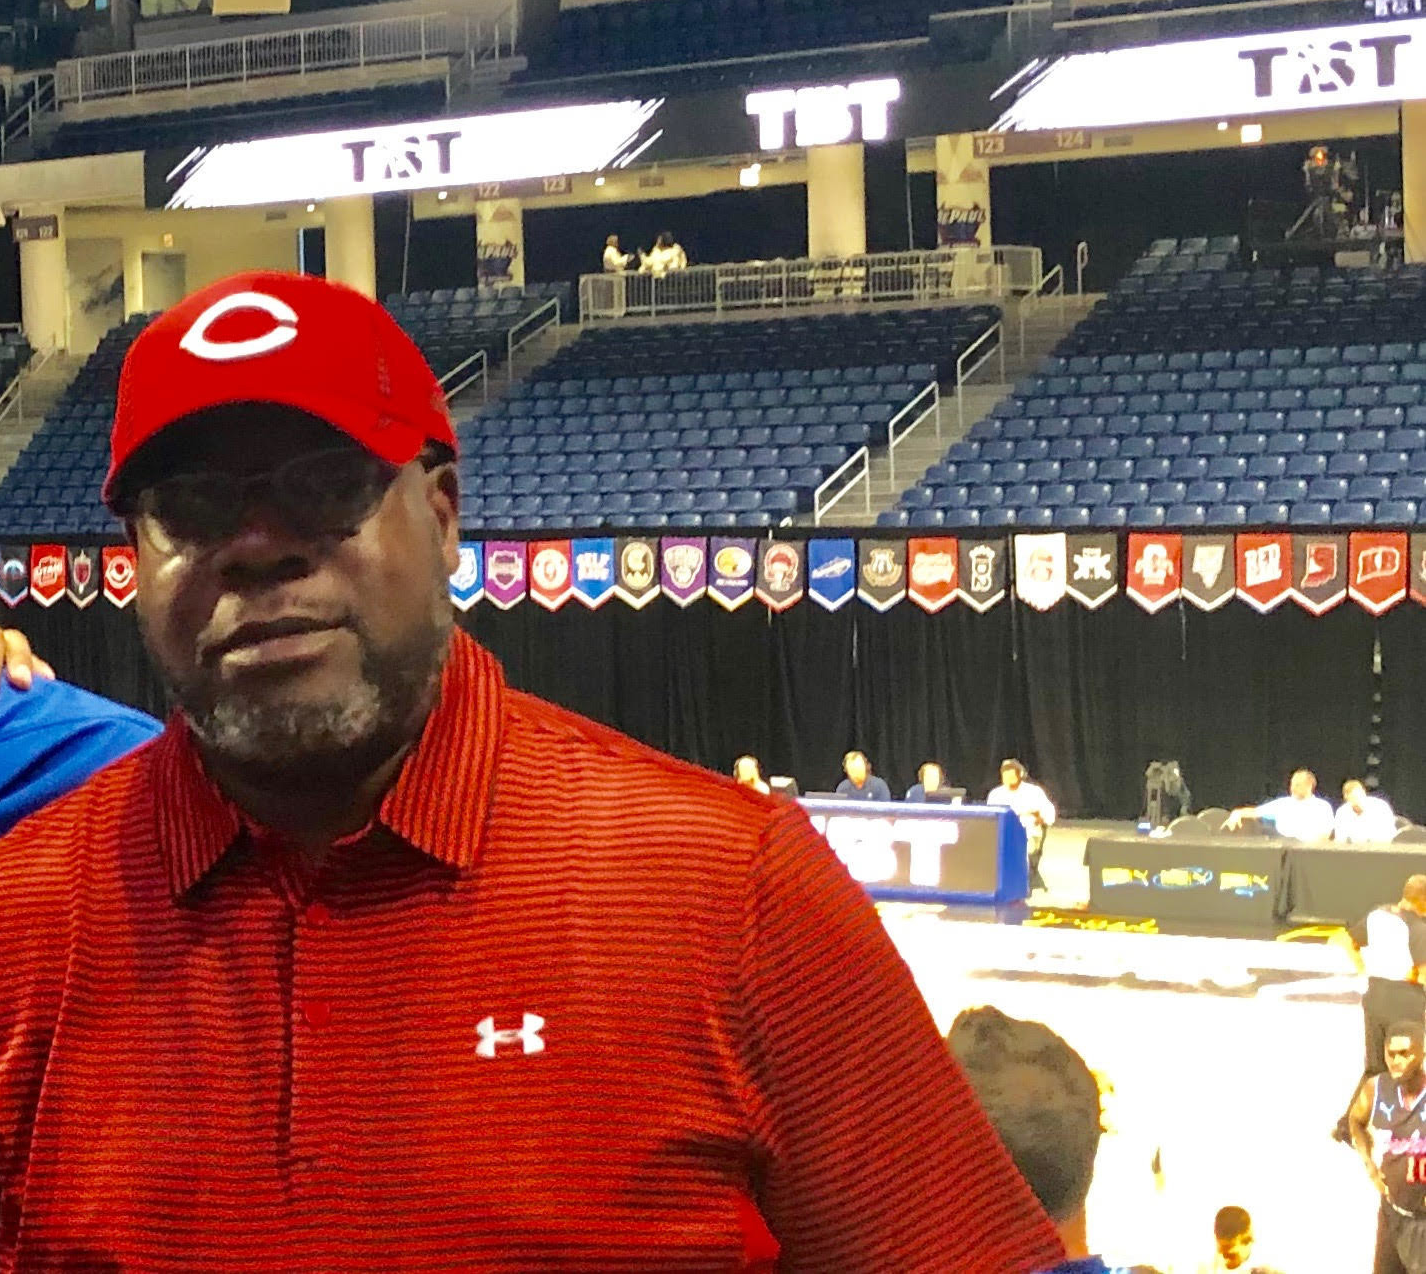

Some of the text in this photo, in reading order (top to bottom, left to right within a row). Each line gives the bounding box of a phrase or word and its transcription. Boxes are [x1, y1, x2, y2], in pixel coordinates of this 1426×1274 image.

[1238, 35, 1412, 97] TBT
[746, 79, 900, 150] TBT
[976, 131, 1085, 153] 123 124
[342, 131, 461, 182] TBT
[542, 177, 567, 192] 123
[179, 292, 299, 362] C
